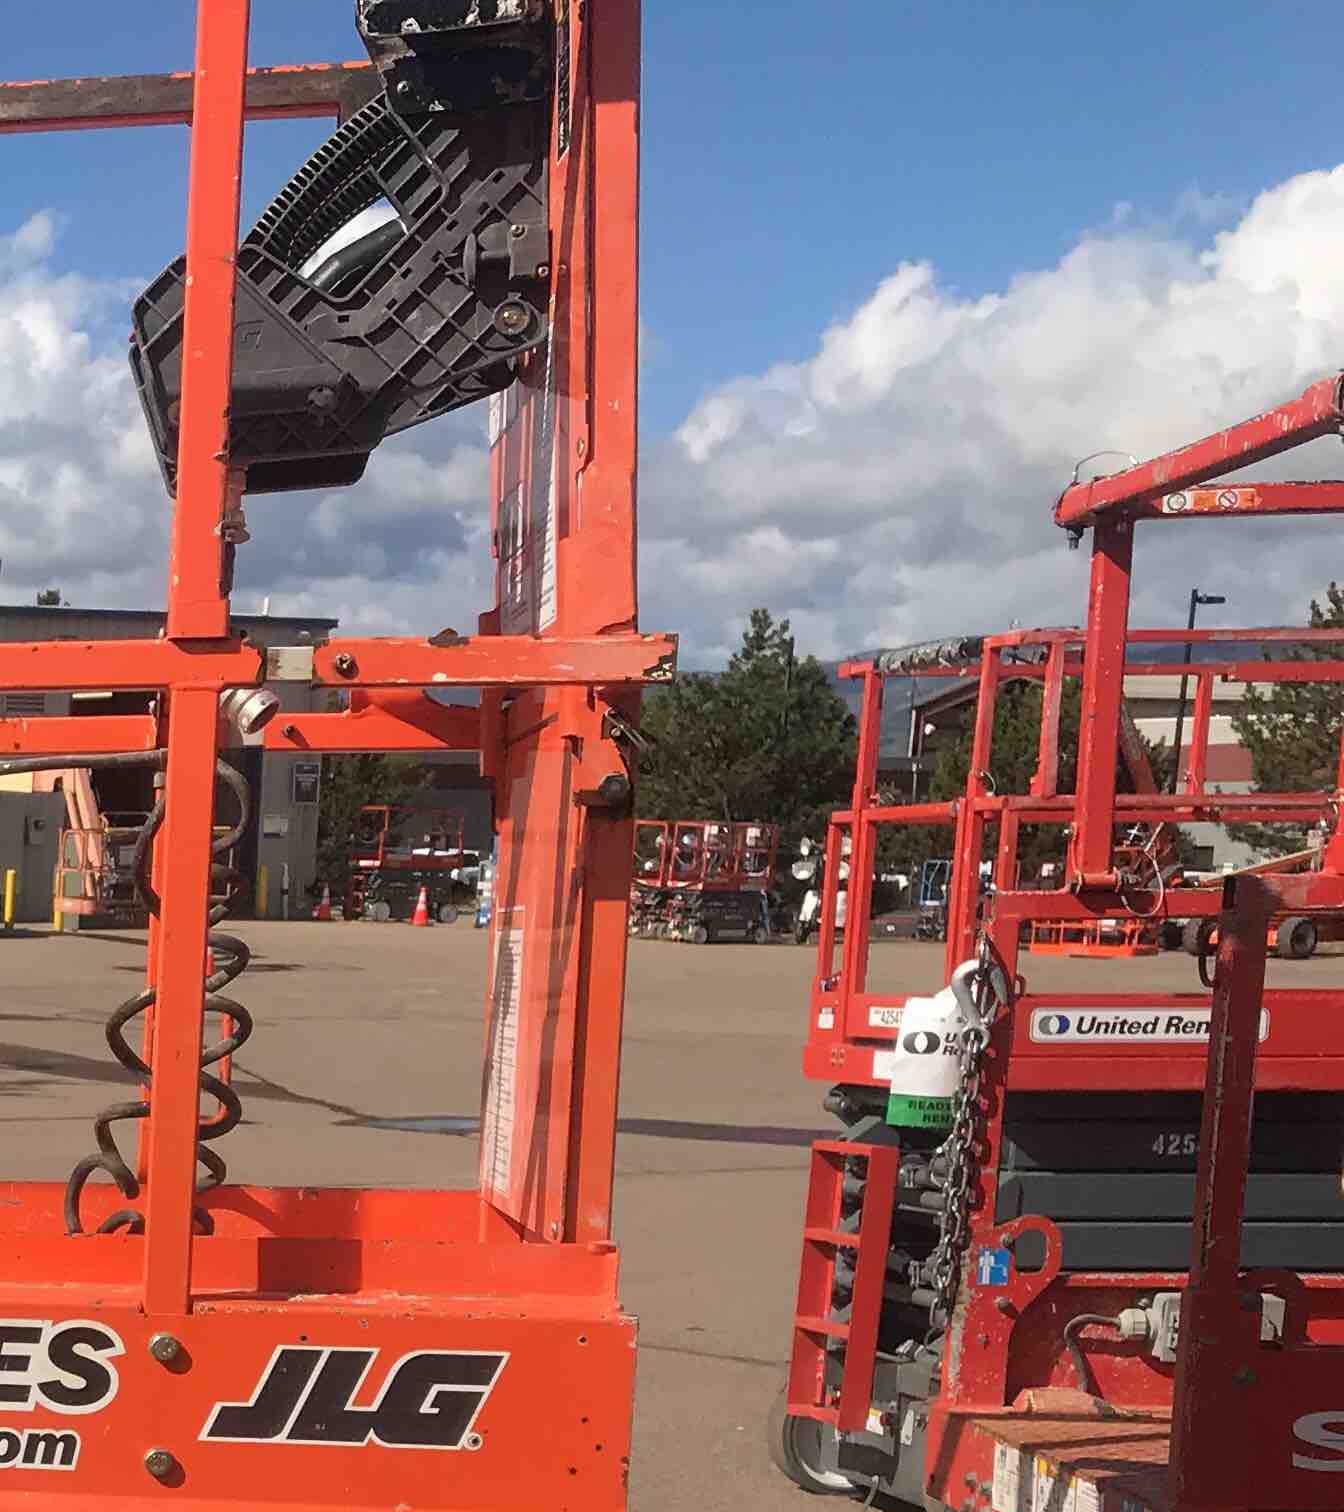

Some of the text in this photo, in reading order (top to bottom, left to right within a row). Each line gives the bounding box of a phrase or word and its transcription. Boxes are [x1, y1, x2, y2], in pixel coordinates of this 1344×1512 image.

[1077, 1015, 1159, 1035] United
[1152, 1134, 1200, 1154] 425
[208, 1347, 502, 1446] JLG
